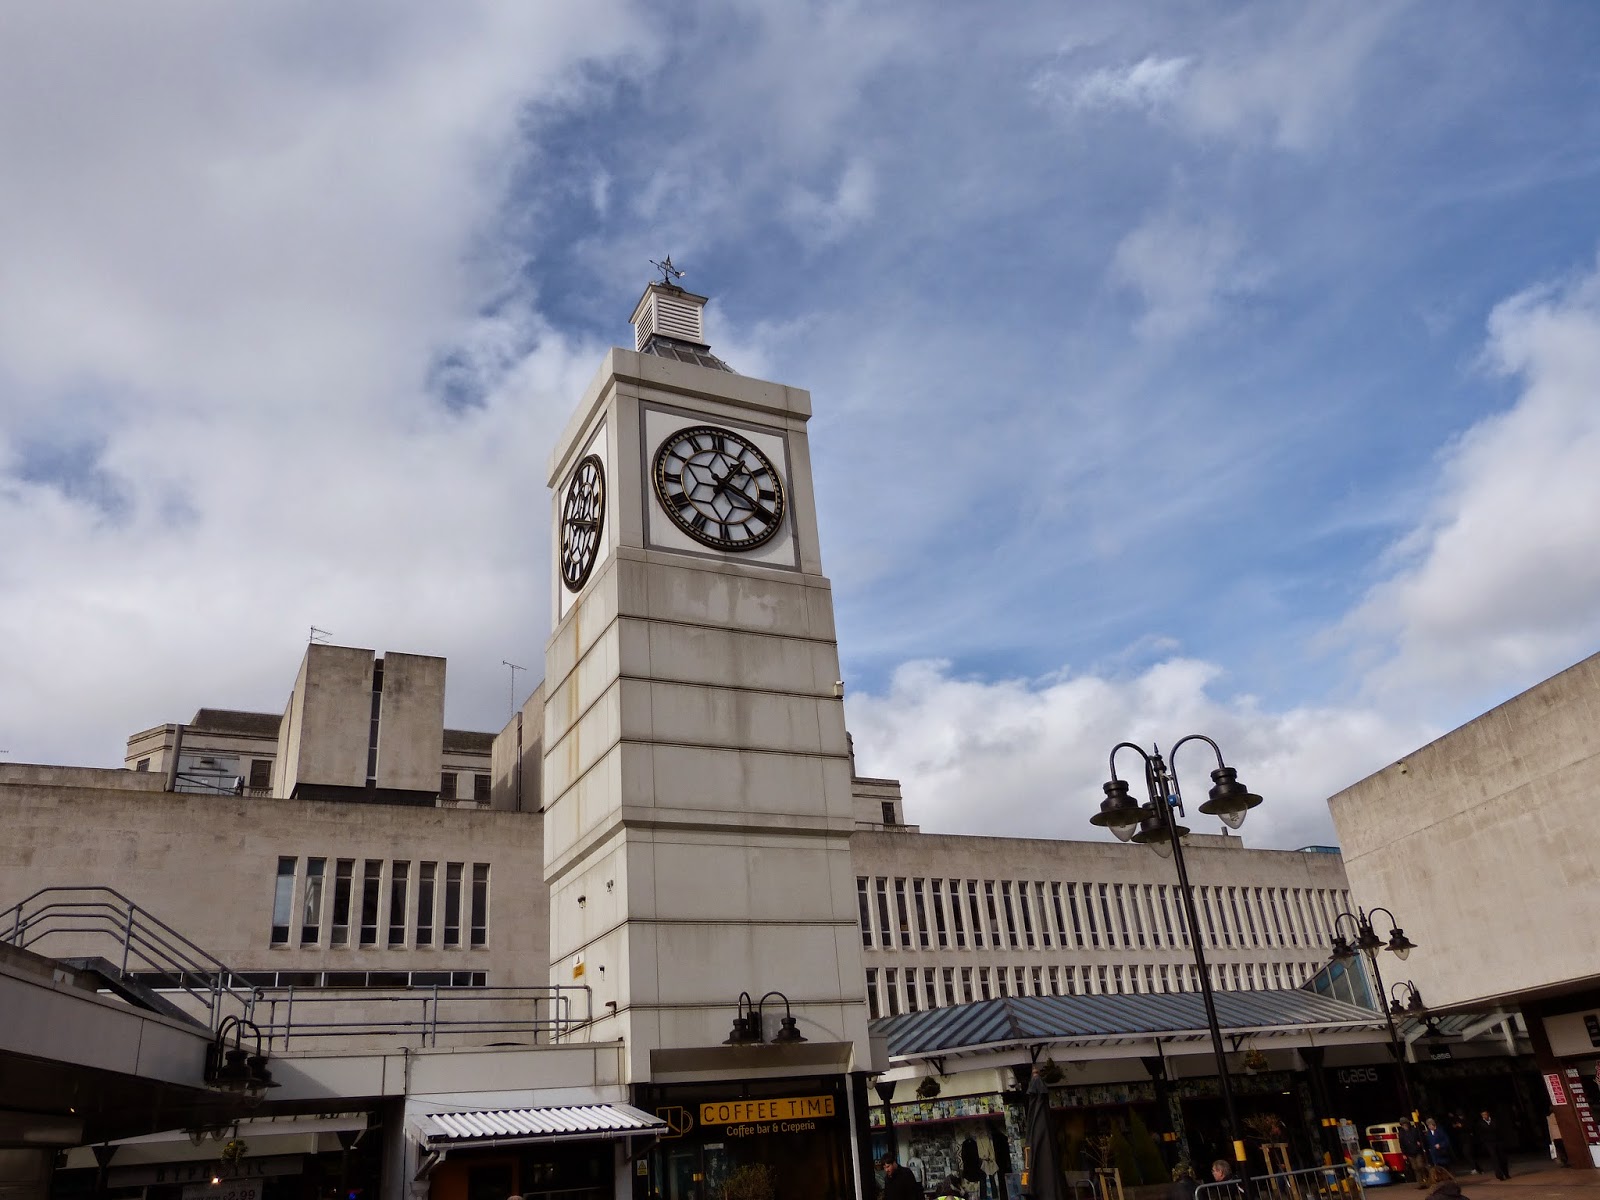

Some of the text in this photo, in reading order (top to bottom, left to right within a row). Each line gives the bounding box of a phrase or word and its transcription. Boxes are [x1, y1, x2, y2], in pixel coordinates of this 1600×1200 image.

[703, 1097, 833, 1123] COFFEE TIME
[726, 1123, 755, 1138] Coffee
[756, 1123, 771, 1135] bar
[772, 1122, 779, 1133] &
